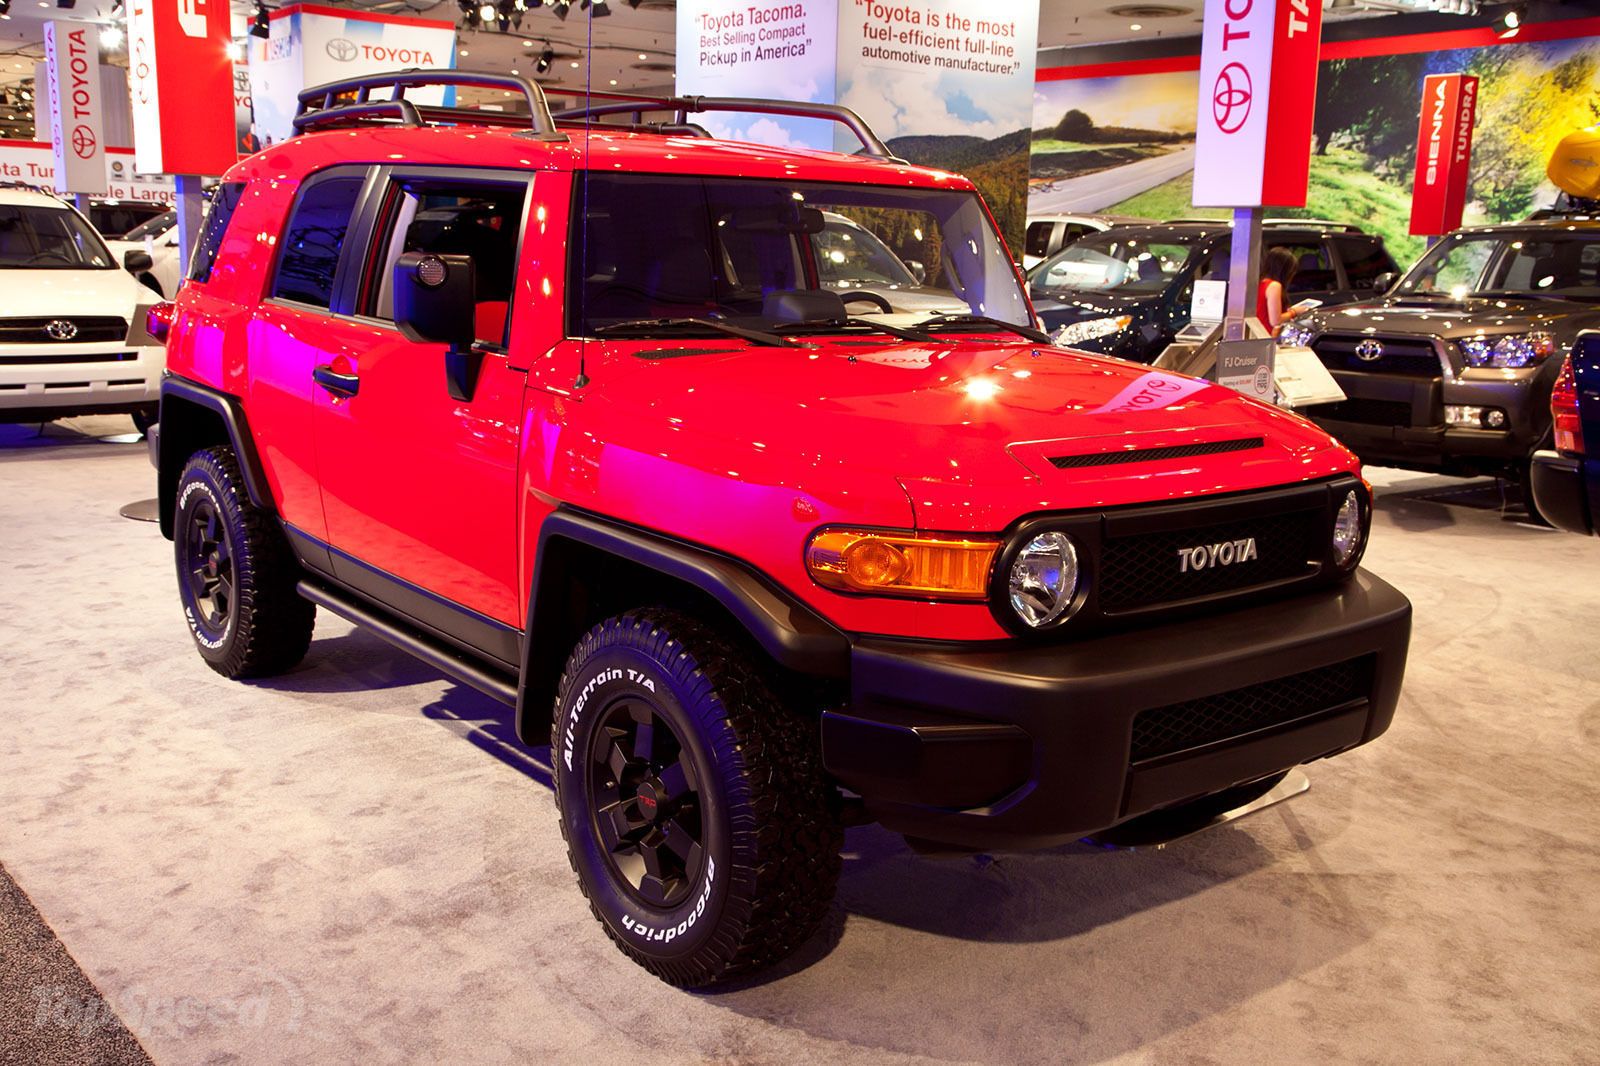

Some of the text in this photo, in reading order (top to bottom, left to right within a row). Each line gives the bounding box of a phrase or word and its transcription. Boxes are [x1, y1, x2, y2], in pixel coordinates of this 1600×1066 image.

[695, 3, 807, 33] “Toyota Tacoma.
[700, 22, 806, 48] Best Selling Compact
[855, 0, 1015, 38] “Toyota is the most
[361, 45, 434, 65] TOYOTA
[700, 39, 812, 67] Pickup in America”
[863, 22, 1014, 58] fuel-efficient full-line
[68, 29, 91, 119] TOYOTA
[862, 45, 1020, 75] automotive manufacturer.”
[1426, 79, 1448, 185] SIENNA
[1456, 81, 1475, 163] TUNDRA
[1234, 356, 1258, 368] Cruiser
[1178, 537, 1258, 573] TOYOTA
[564, 667, 623, 772] All-Terrain
[621, 855, 715, 943] BFGoodrich
